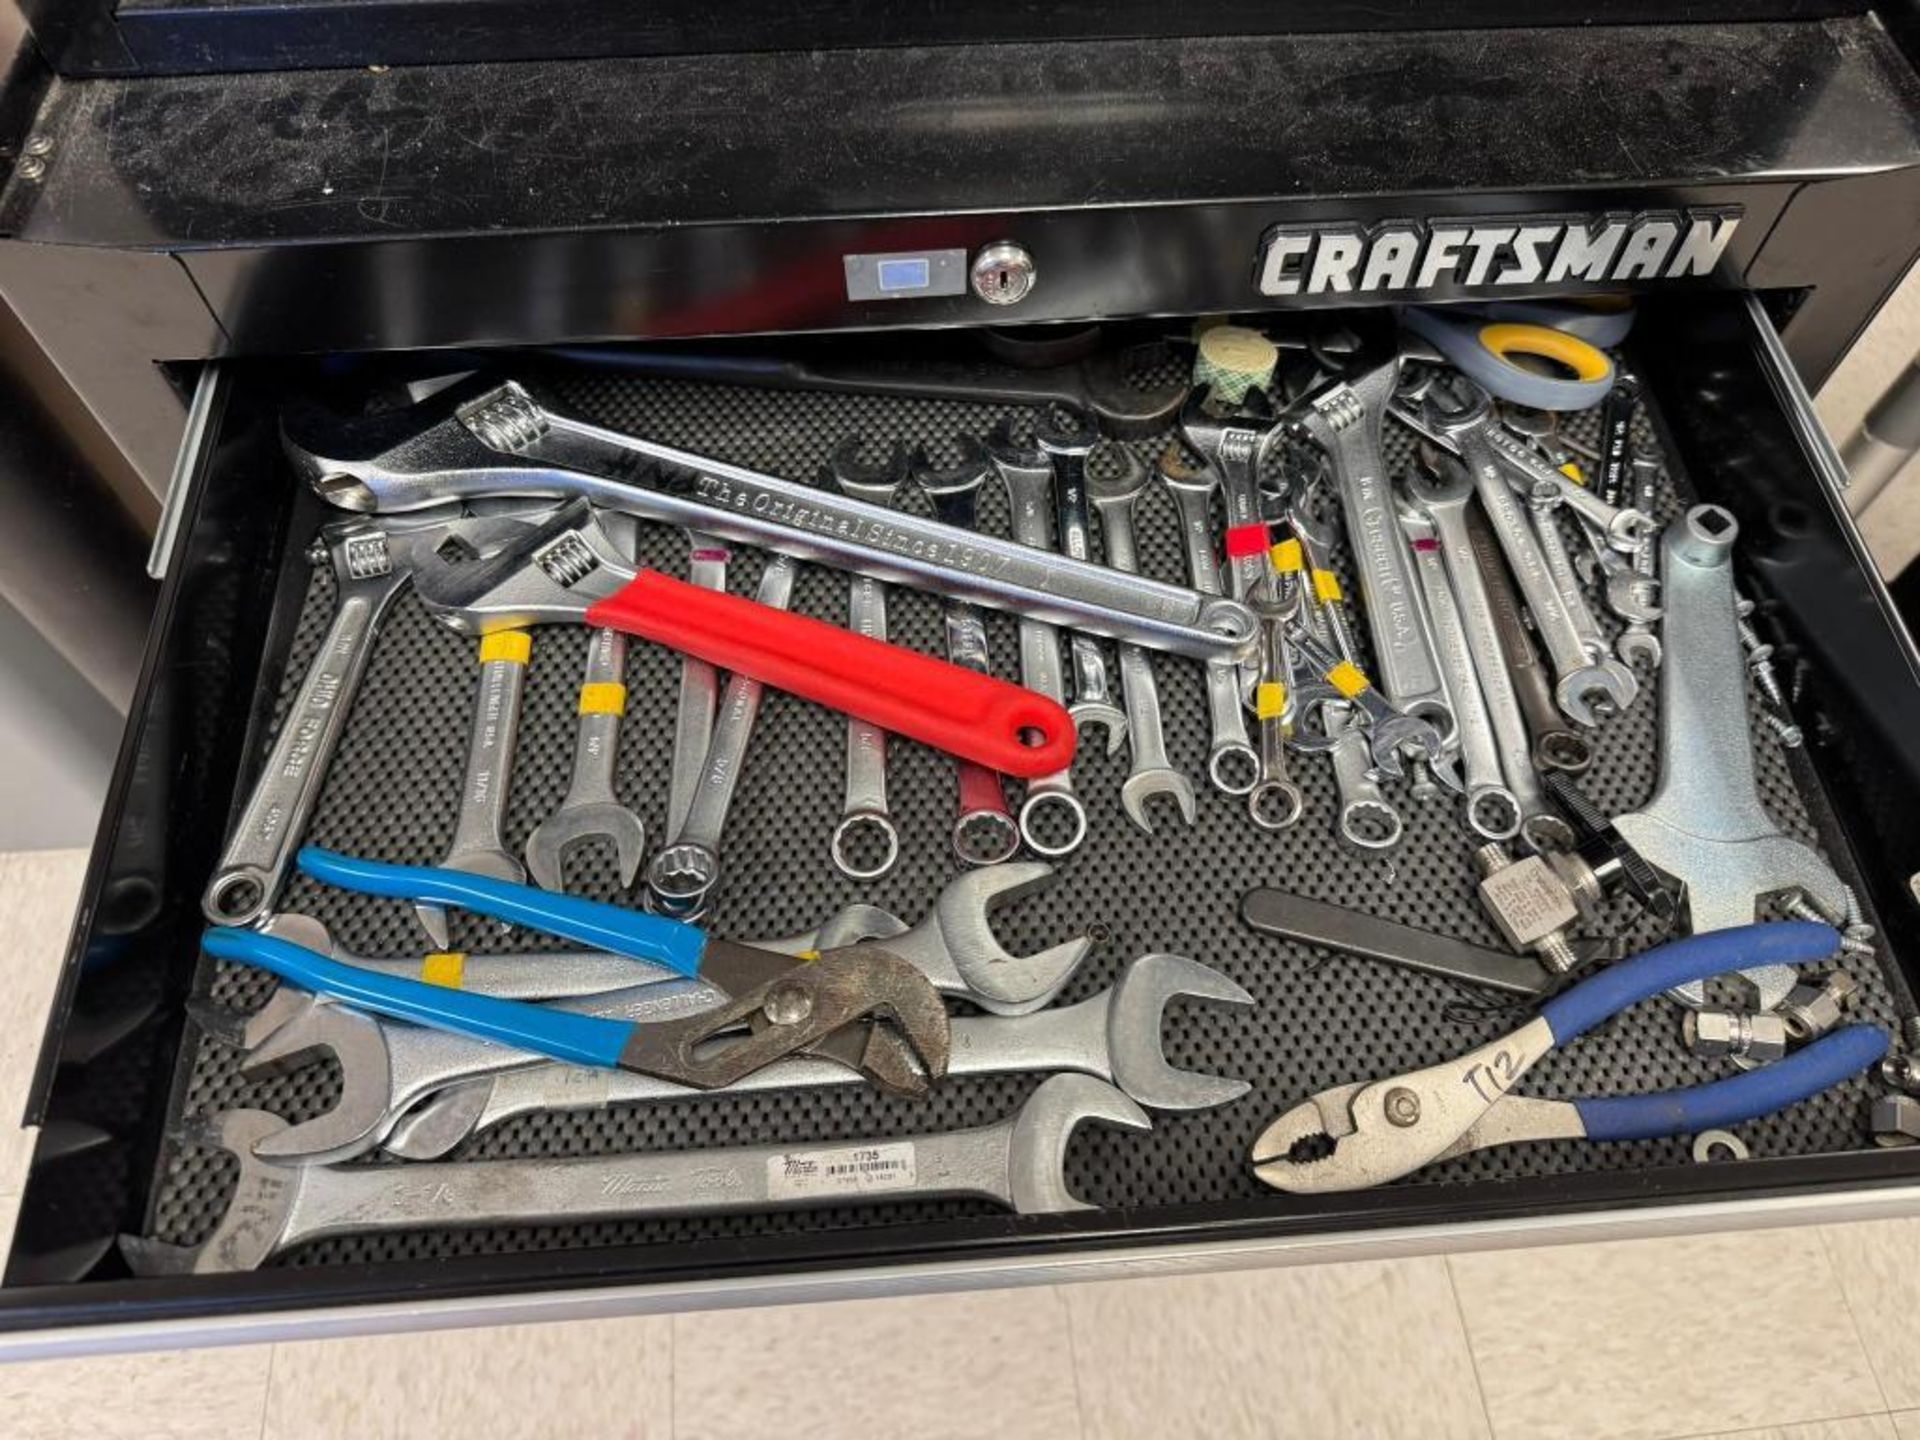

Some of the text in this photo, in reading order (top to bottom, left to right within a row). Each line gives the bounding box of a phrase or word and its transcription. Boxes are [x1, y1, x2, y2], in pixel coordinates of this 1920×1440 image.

[1257, 215, 1742, 297] CRAFTSMAN
[751, 491, 866, 540] Original
[1462, 1050, 1526, 1104] T12
